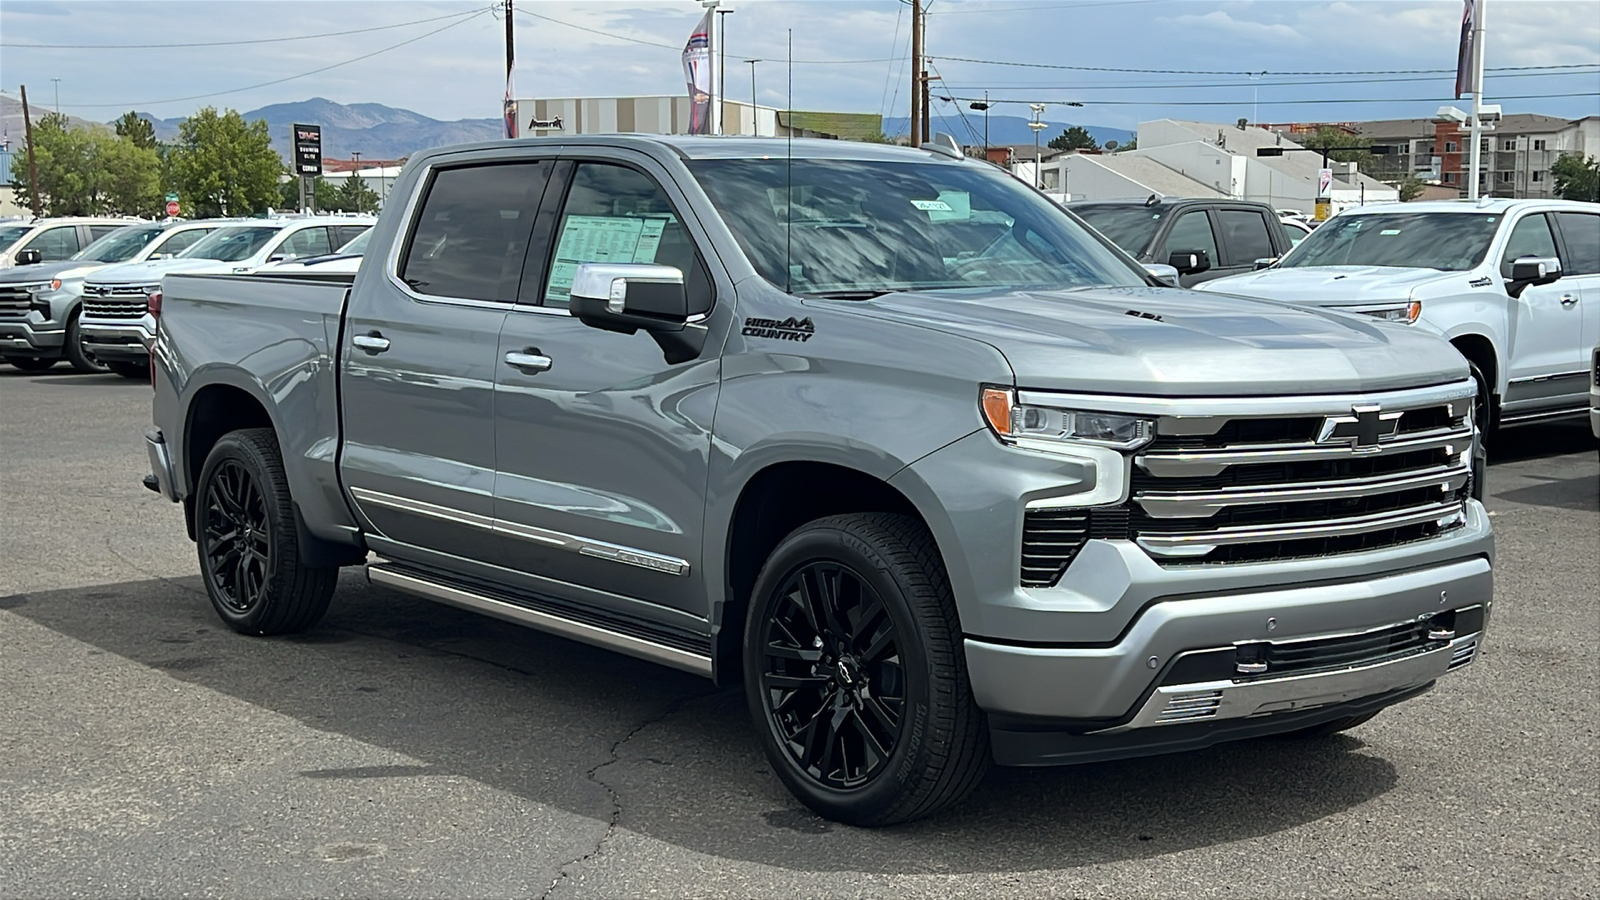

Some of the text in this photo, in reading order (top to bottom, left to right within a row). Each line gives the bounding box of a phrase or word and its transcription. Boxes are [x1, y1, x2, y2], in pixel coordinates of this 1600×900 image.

[745, 317, 782, 329] HIGH
[741, 327, 813, 343] COUNTRY
[898, 702, 928, 784] BRIDGESTONE
